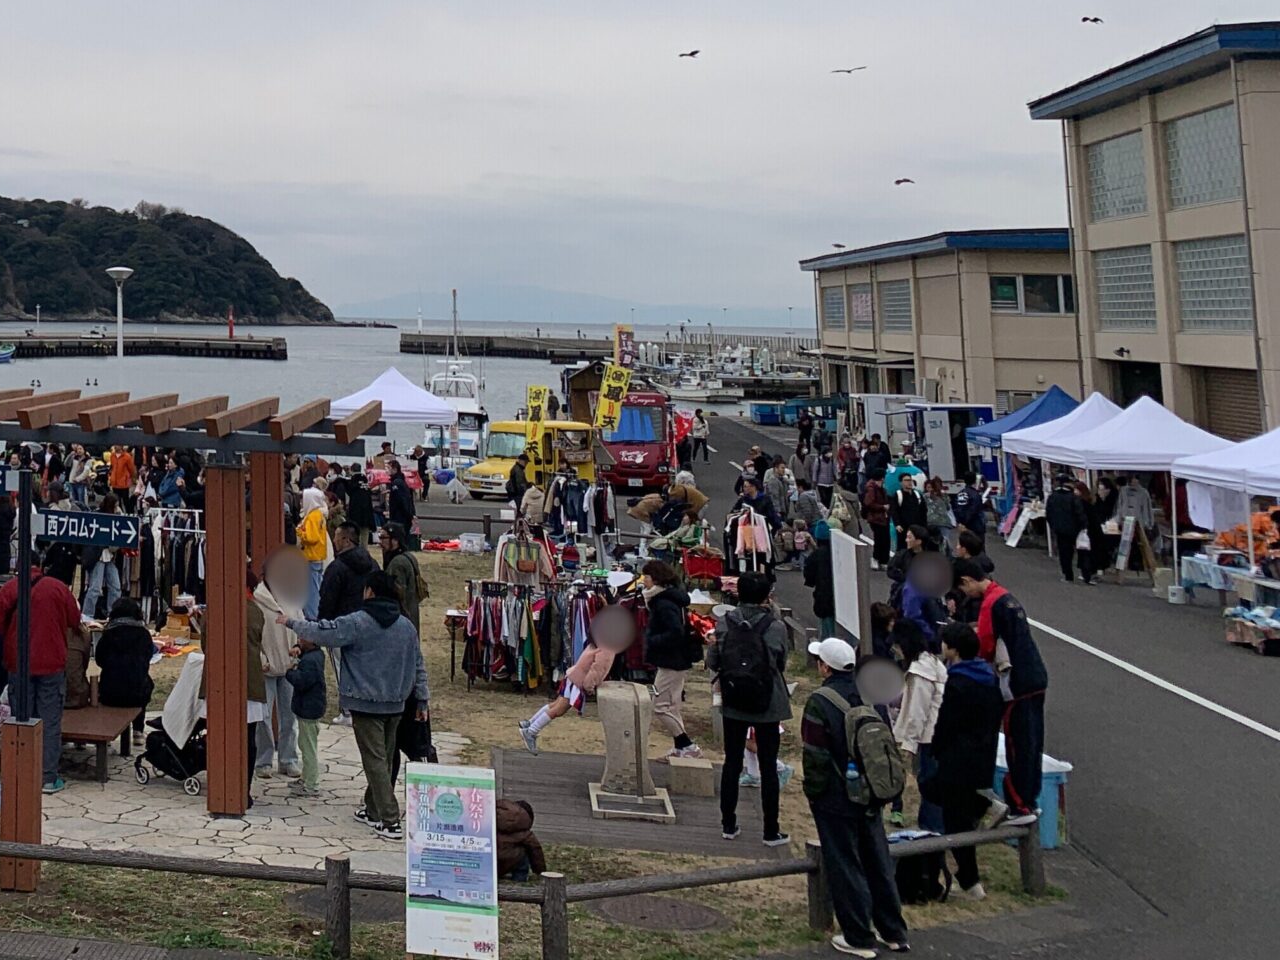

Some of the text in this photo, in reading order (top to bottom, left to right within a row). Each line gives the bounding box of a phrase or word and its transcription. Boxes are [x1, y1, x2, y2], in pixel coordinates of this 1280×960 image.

[47, 516, 120, 540] 西プロムナード
[426, 833, 445, 842] 3/15
[460, 837, 475, 845] 4/5
